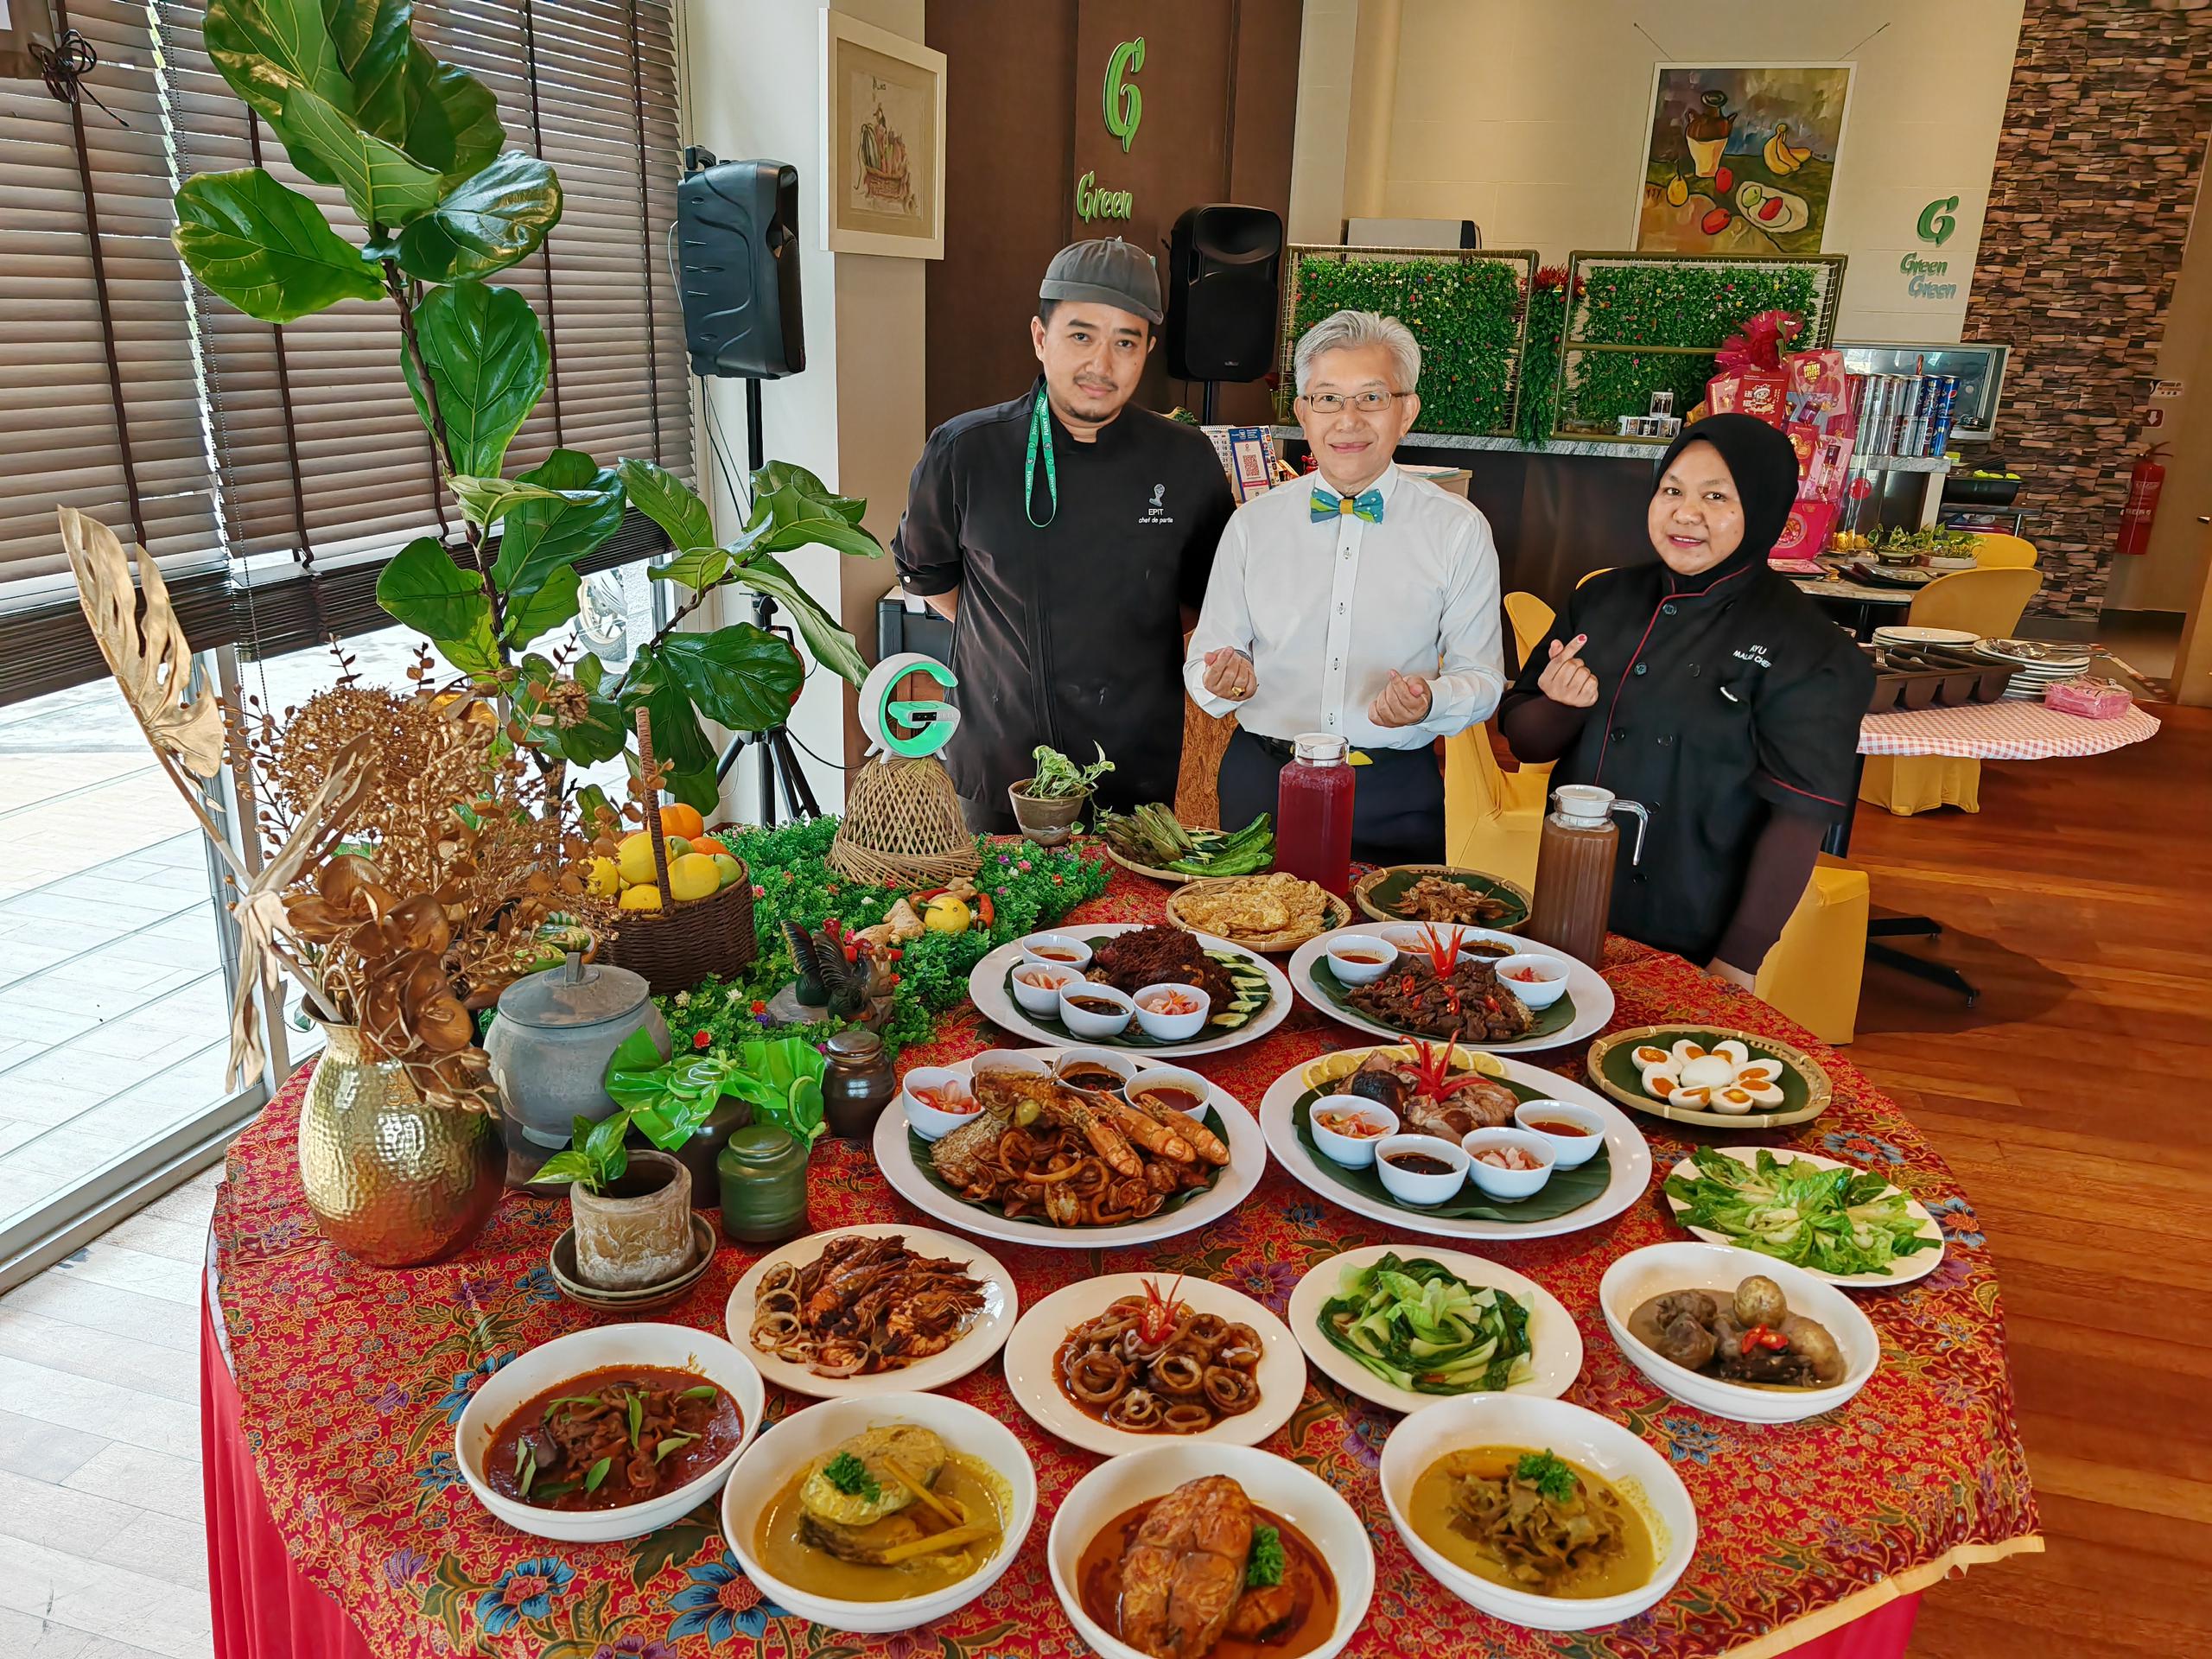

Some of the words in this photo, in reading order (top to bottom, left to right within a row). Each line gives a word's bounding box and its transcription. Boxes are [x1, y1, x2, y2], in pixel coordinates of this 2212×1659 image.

[1103, 36, 1146, 152] G
[1077, 170, 1133, 224] Green
[1917, 195, 1959, 247] G
[1900, 251, 1948, 276] Green
[1908, 274, 1957, 298] Green
[1036, 396, 1045, 414] FUNKY
[1159, 517, 1173, 525] partie
[1749, 645, 1768, 655] AYU
[1754, 655, 1772, 669] CHEF
